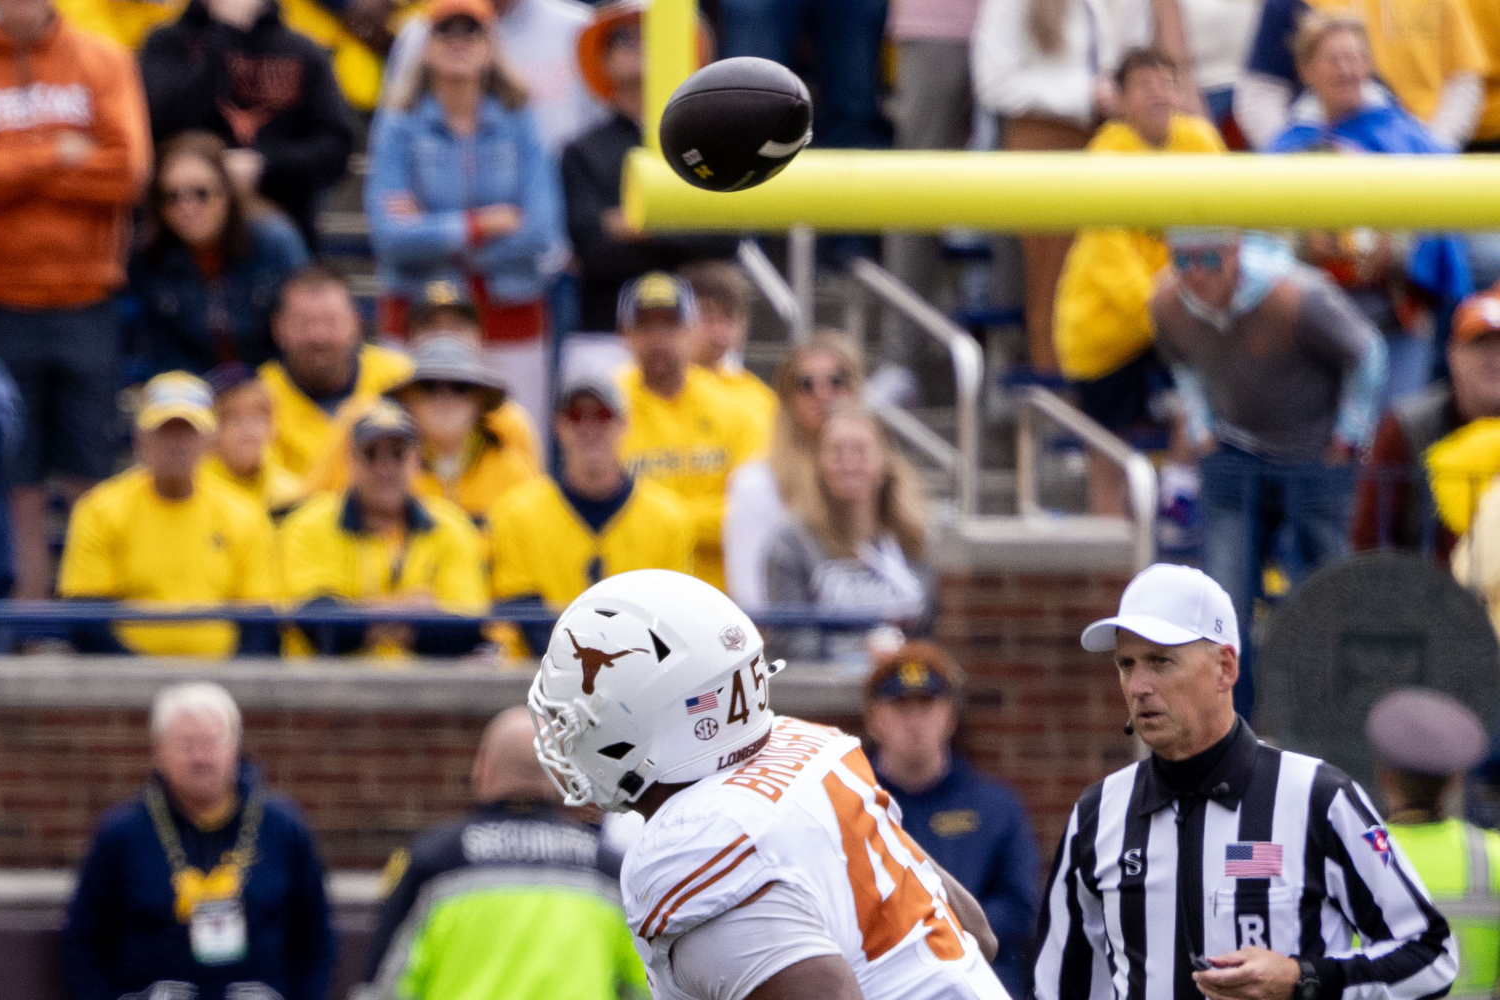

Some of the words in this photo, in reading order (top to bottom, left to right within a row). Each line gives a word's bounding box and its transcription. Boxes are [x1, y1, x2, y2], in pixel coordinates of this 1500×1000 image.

[1214, 618, 1223, 634] S
[727, 654, 769, 725] 45
[695, 719, 718, 739] SEC
[821, 745, 967, 961] 45
[1123, 848, 1142, 876] S
[1238, 914, 1269, 948] R
